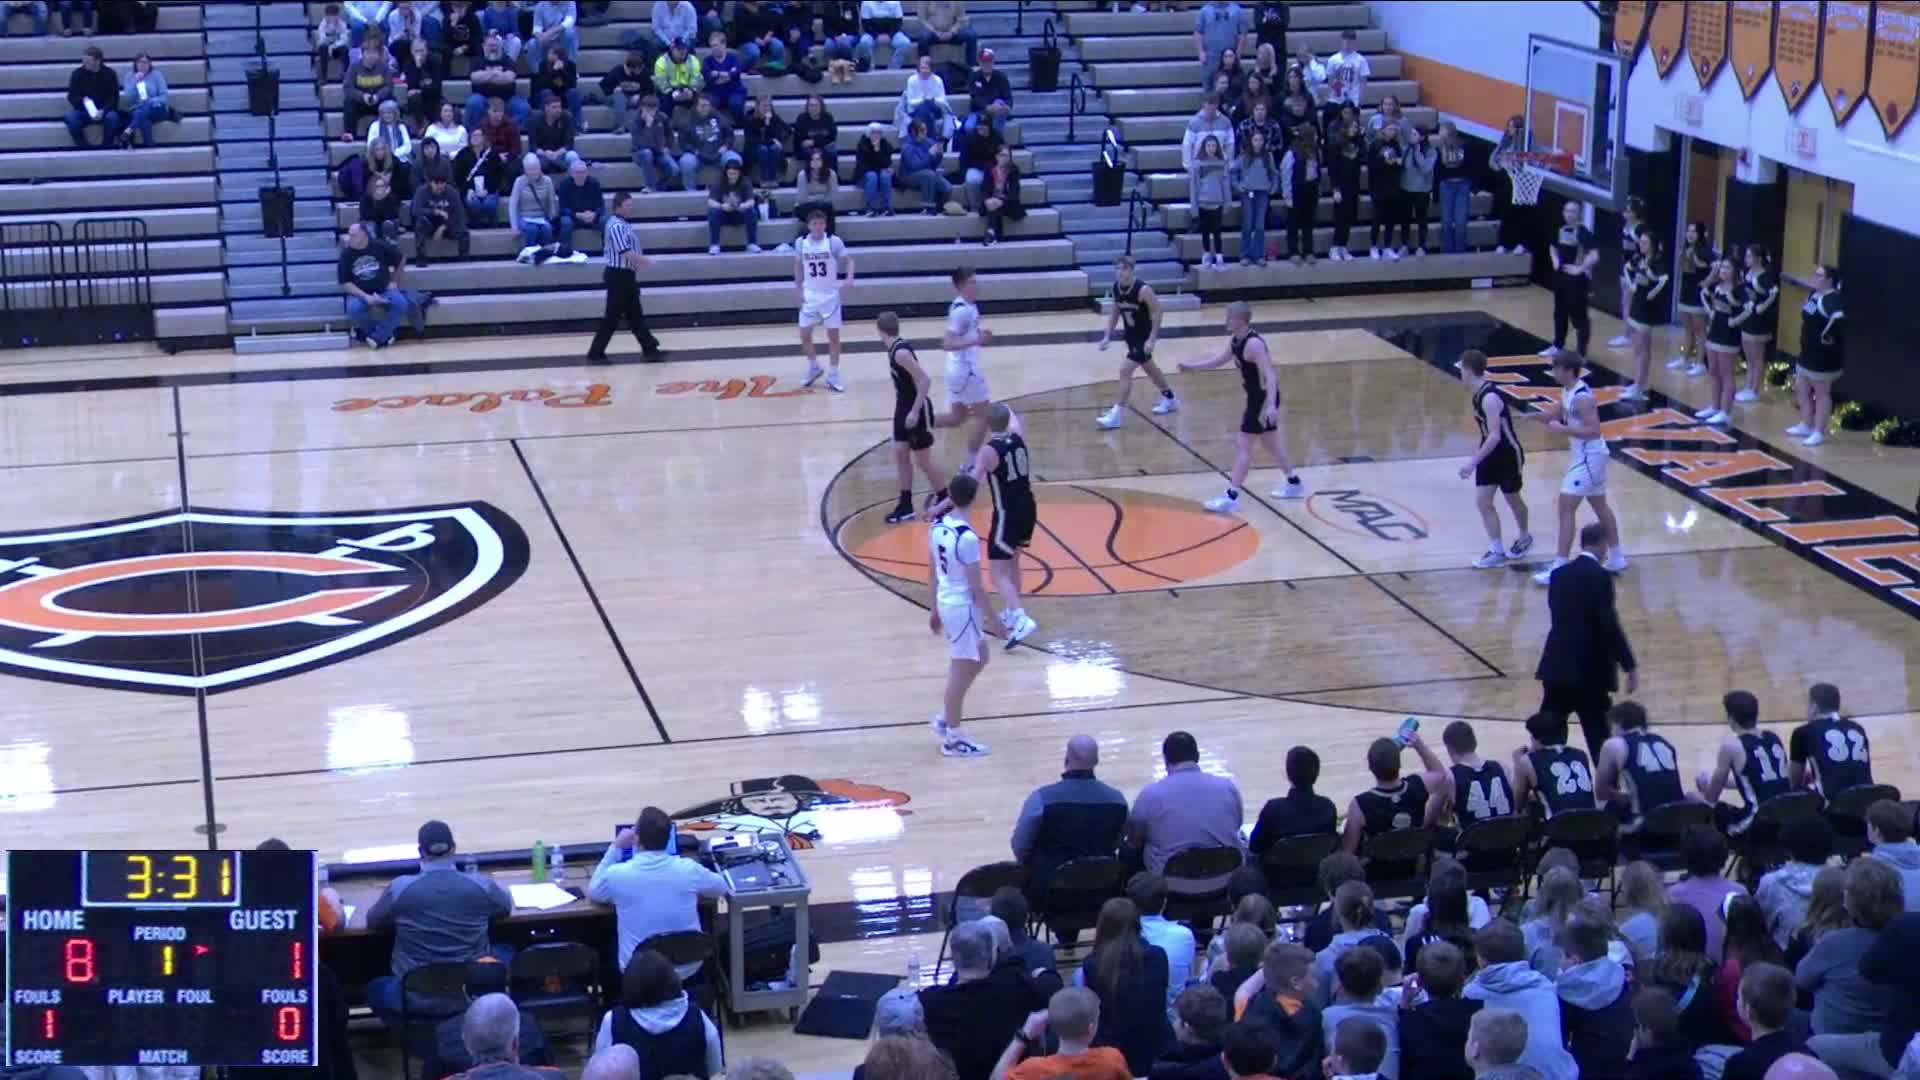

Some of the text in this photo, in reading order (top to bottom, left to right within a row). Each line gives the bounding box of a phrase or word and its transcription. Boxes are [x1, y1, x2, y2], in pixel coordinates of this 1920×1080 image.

[808, 261, 828, 278] 33
[332, 375, 817, 413] The Palace
[1003, 446, 1029, 482] 10
[1635, 741, 1676, 773] 40
[1824, 728, 1869, 763] 32
[1466, 775, 1511, 820] 44
